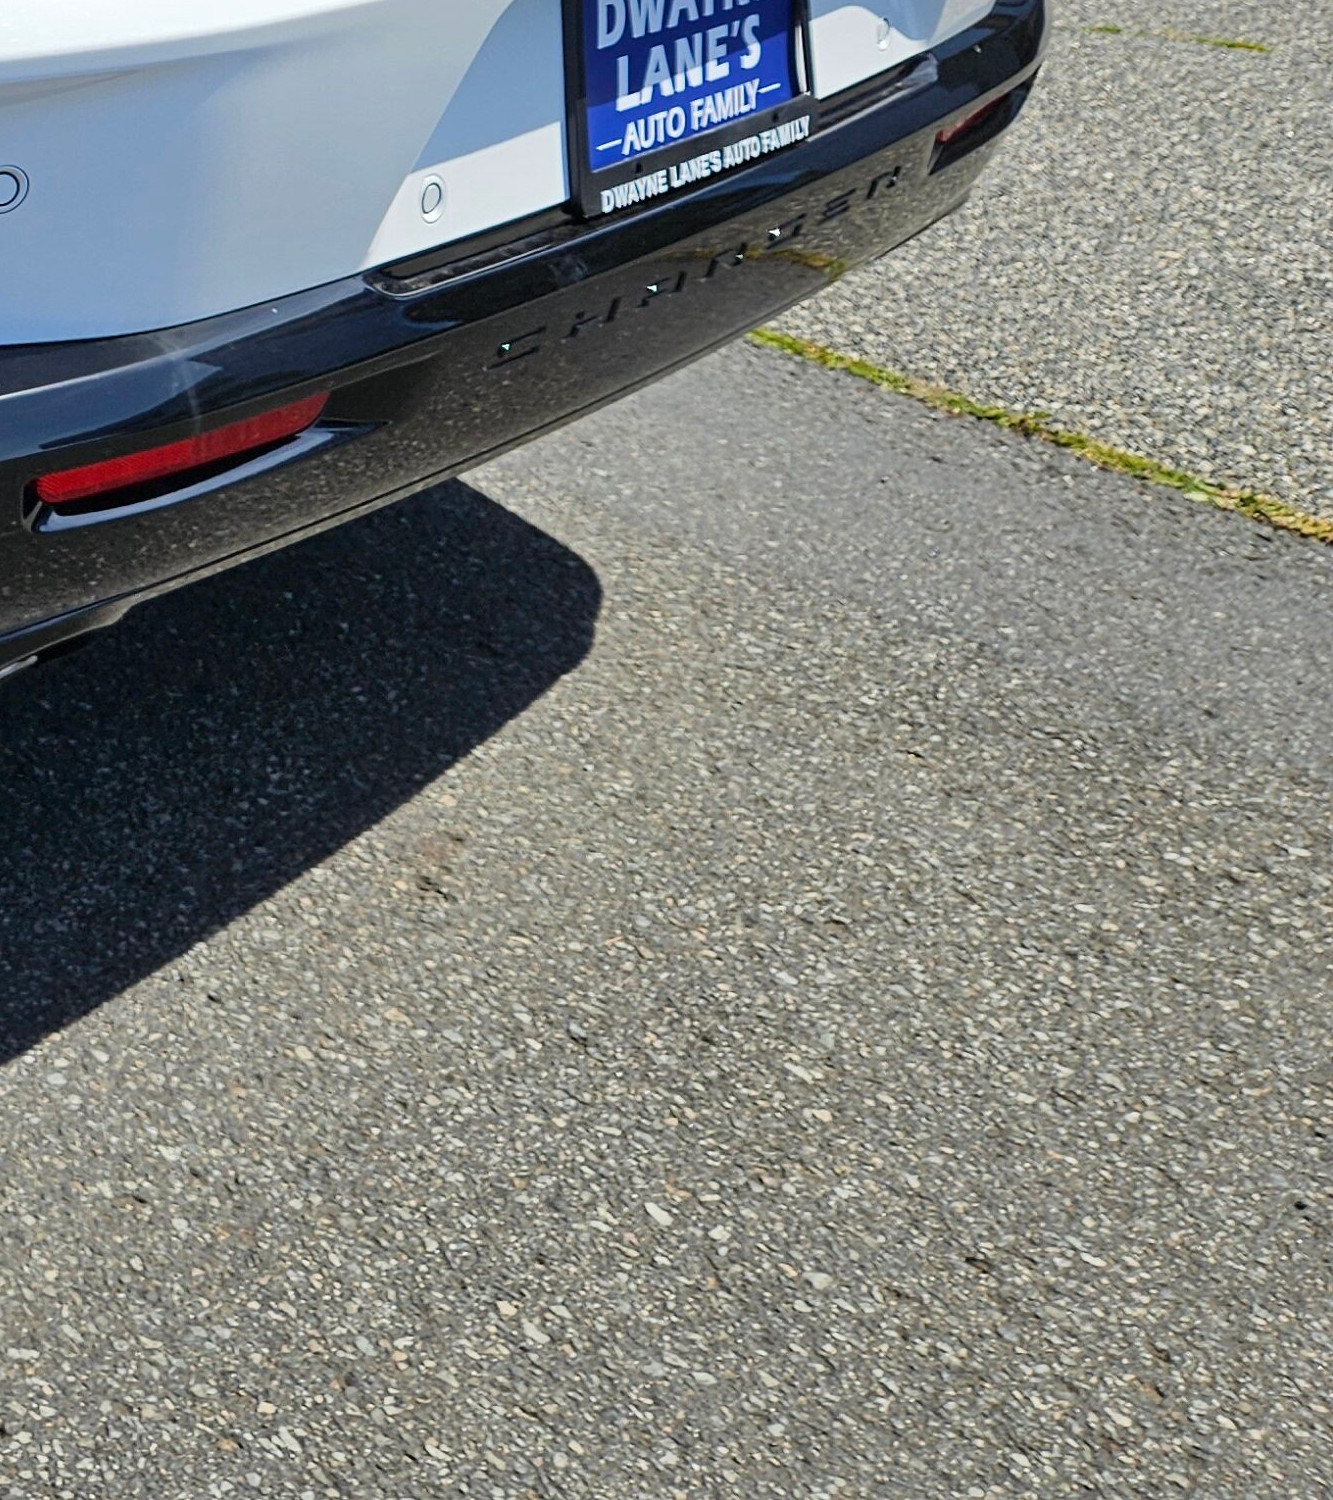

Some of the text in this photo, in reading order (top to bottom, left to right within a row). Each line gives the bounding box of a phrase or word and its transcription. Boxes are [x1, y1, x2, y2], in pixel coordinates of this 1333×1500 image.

[615, 13, 762, 112] LANE'S
[600, 171, 669, 214] DWAYNE
[722, 132, 763, 171] AUTO
[760, 115, 811, 154] FAMILY
[621, 77, 761, 156] AUTO FAMILY
